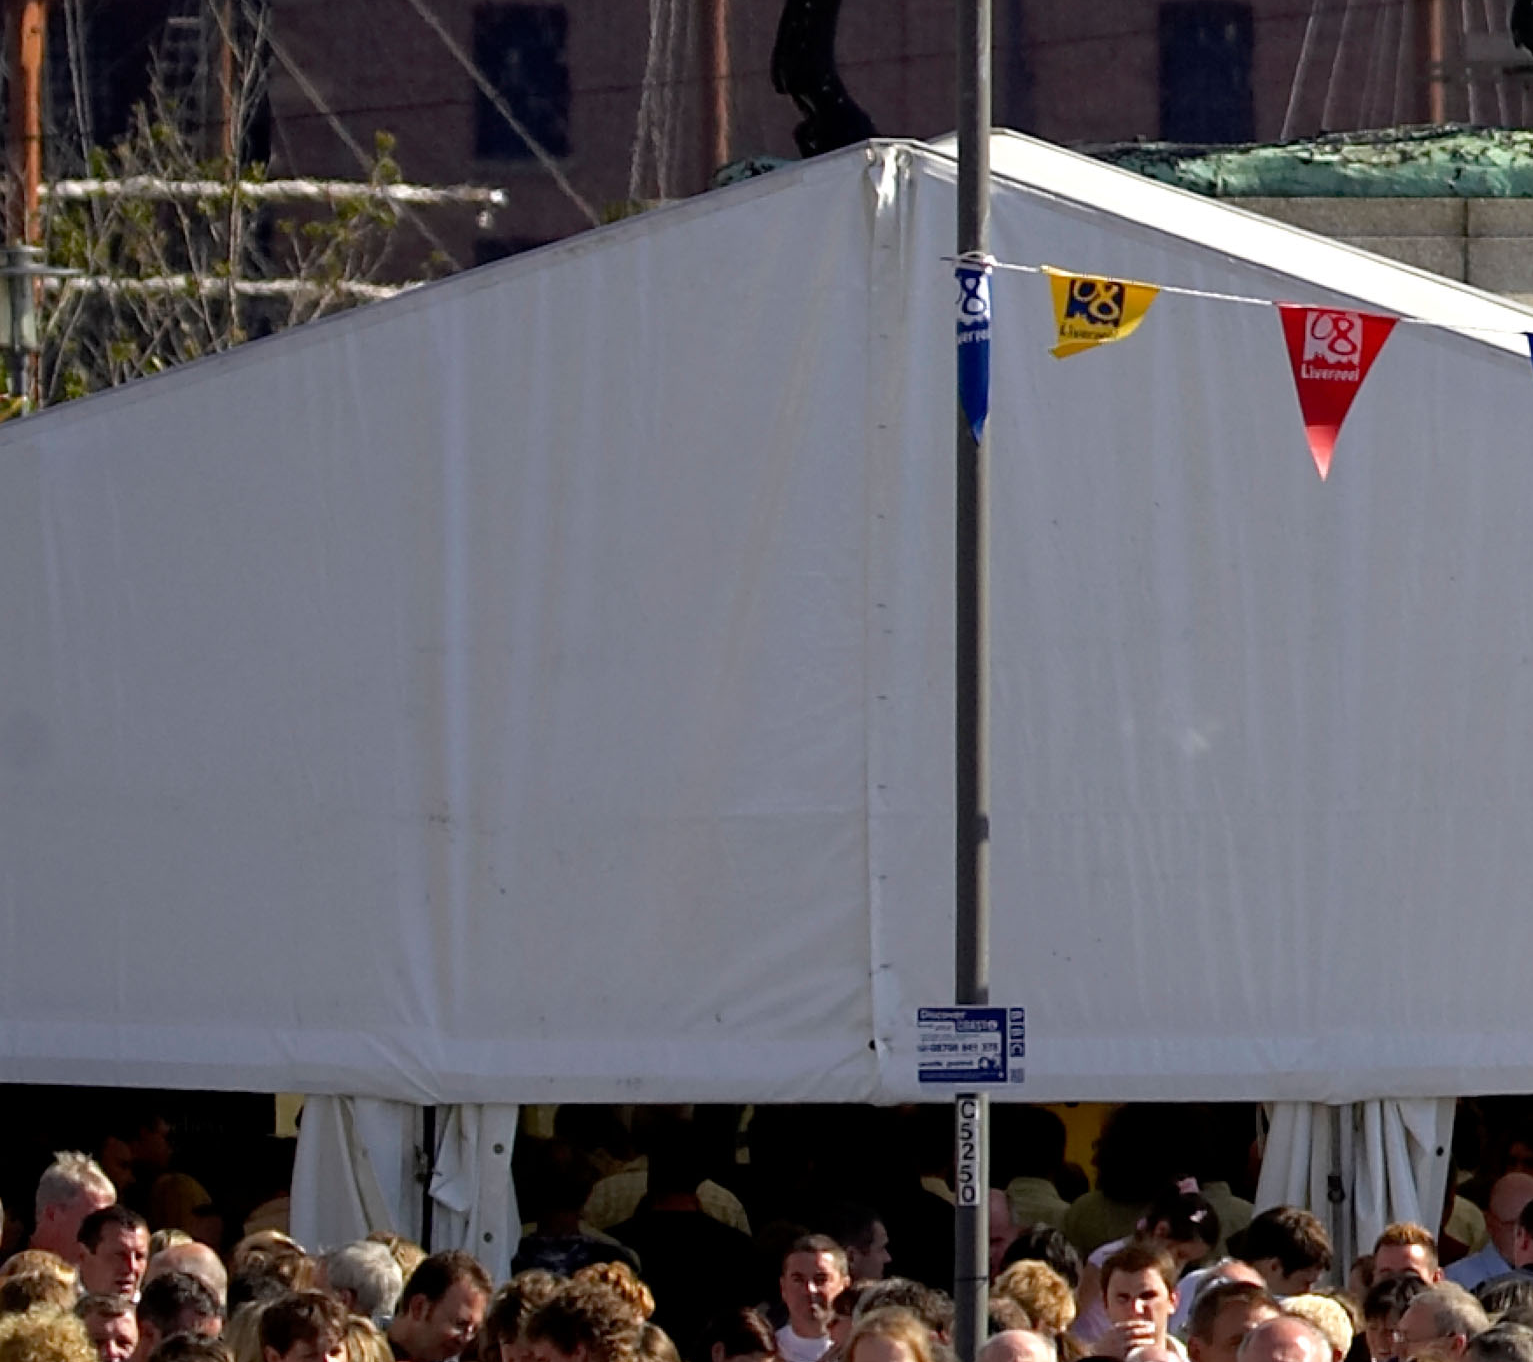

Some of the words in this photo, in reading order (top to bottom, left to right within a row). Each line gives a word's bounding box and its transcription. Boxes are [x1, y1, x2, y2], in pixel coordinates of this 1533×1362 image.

[1072, 281, 1120, 320] 08
[1311, 314, 1358, 356] 08
[1301, 363, 1360, 381] Liverpool
[959, 1100, 976, 1203] C5250
